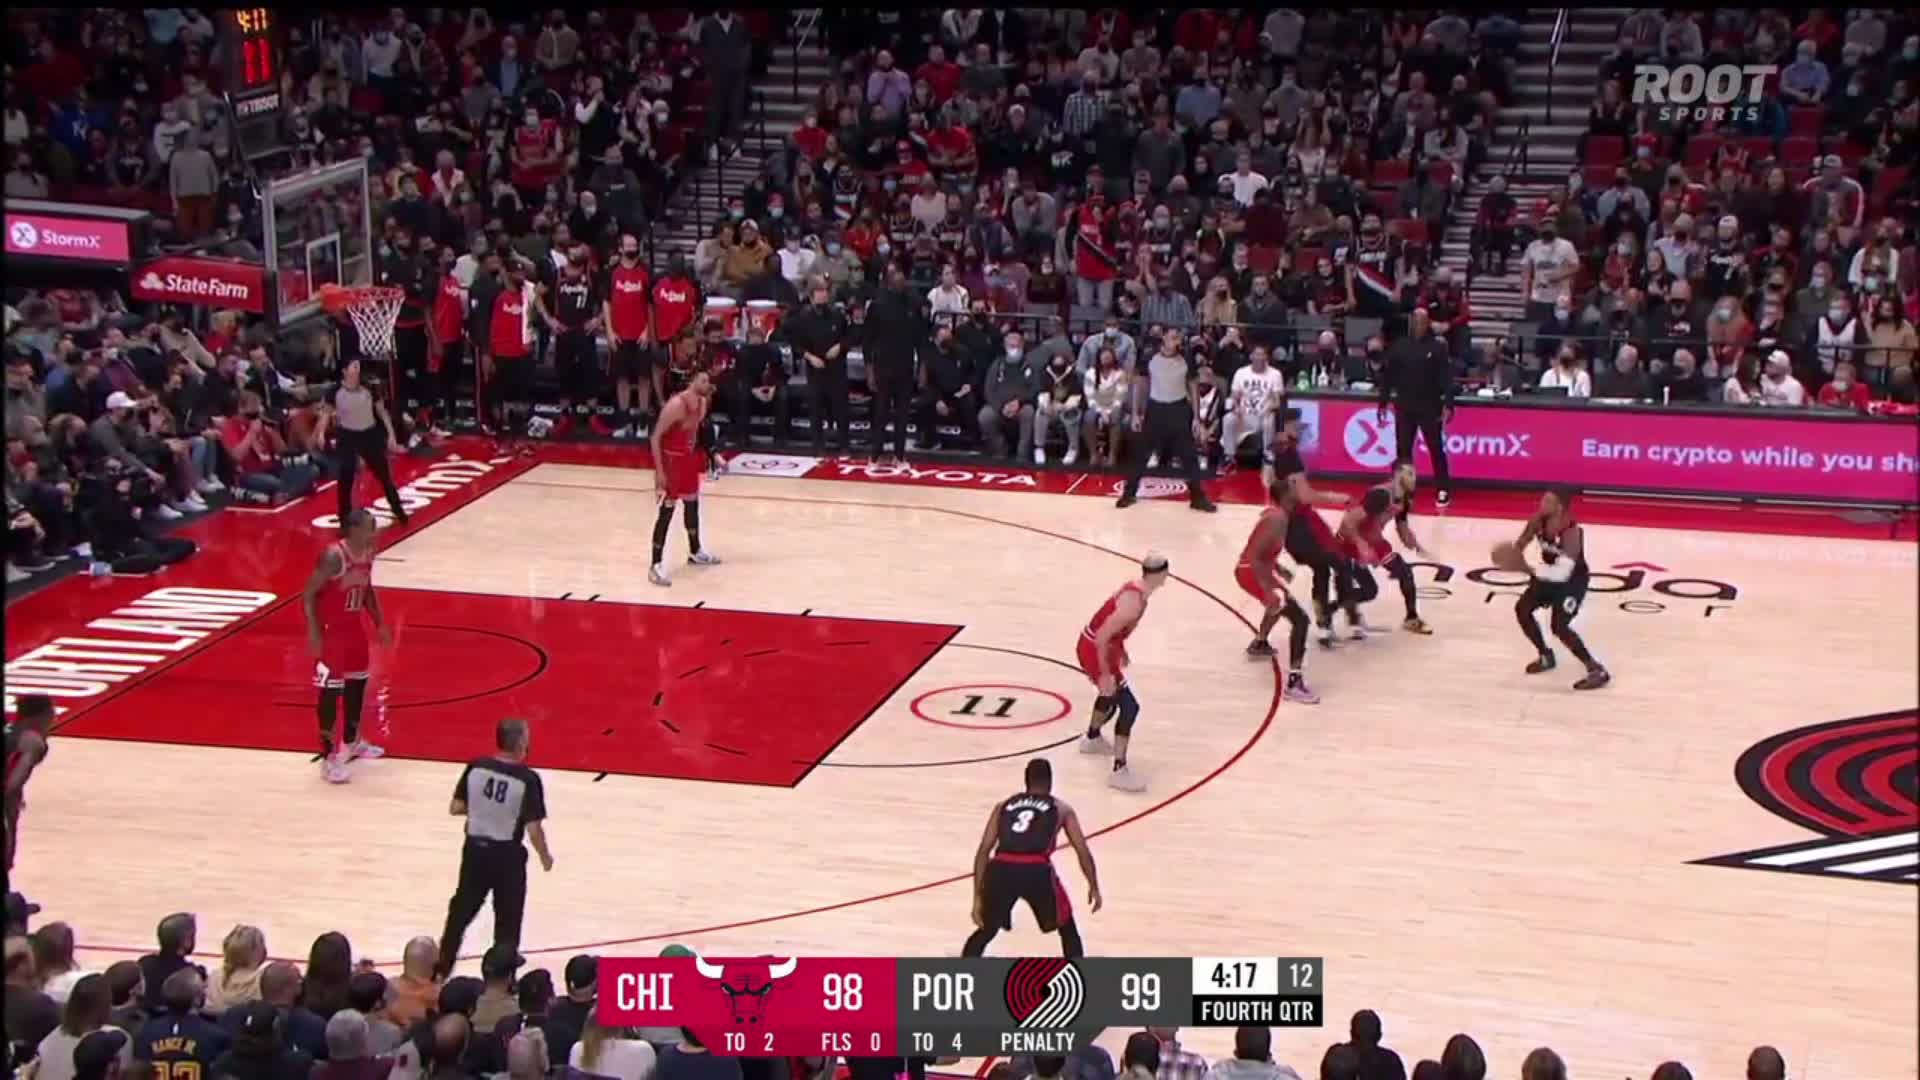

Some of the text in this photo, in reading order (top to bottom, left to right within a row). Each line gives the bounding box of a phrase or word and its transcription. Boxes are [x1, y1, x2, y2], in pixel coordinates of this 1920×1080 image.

[42, 230, 101, 248] StormX
[1582, 438, 1639, 459] Earn
[1647, 446, 1733, 467] crypto
[1741, 447, 1814, 468] while
[1821, 454, 1873, 473] you
[837, 464, 1038, 487] TOYOTA
[949, 694, 1018, 718] 11
[483, 777, 508, 804] 48
[1011, 810, 1035, 833] 3
